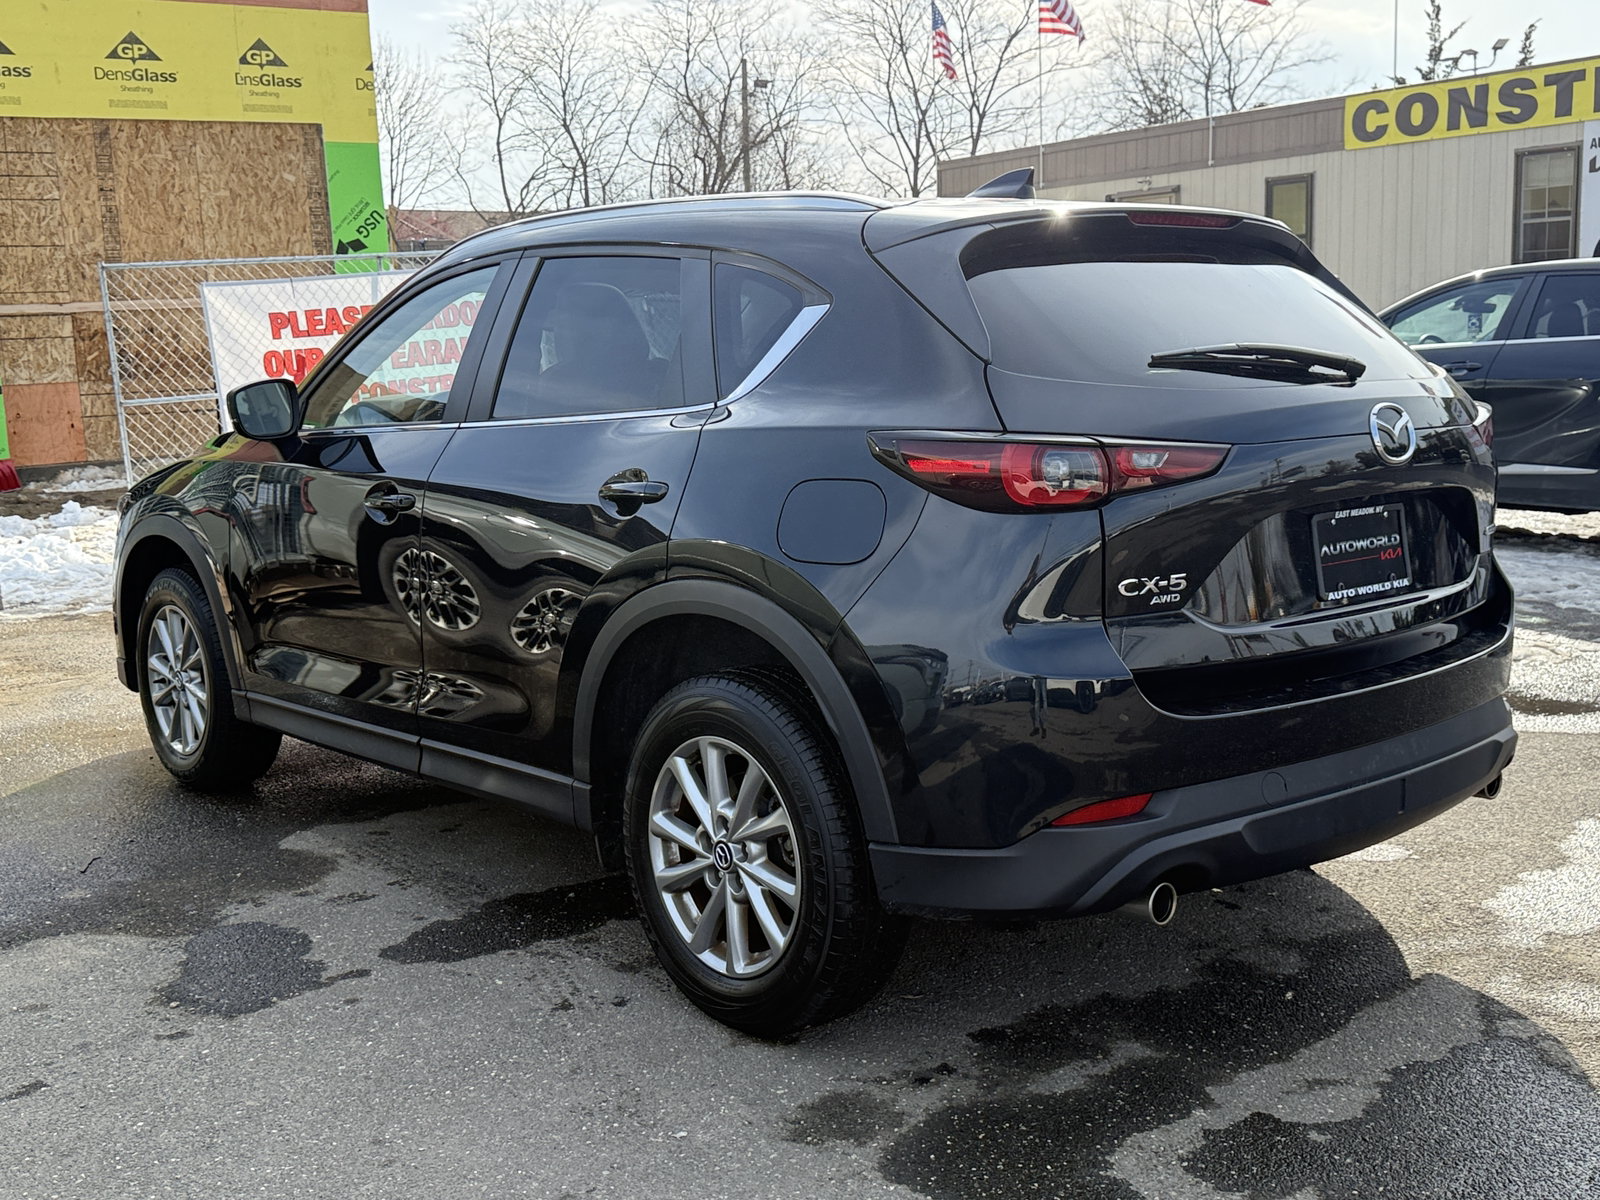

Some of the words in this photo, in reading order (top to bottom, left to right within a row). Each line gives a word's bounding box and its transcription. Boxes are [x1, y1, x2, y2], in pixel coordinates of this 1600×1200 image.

[116, 43, 148, 59] GP
[245, 50, 275, 65] GP
[0, 65, 32, 78] ass
[94, 66, 178, 83] DensGlass
[120, 85, 153, 94] Sheathing
[356, 77, 375, 91] De
[249, 89, 280, 99] Sheathing
[355, 209, 385, 239] USG
[351, 373, 455, 404] CONSTR
[1335, 509, 1350, 519] EAST
[1375, 505, 1384, 514] NY
[1320, 533, 1401, 557] AUTOWORLD
[1117, 573, 1187, 597] CX-5
[1328, 588, 1356, 601] AUTO
[1357, 583, 1392, 596] WORLD
[1392, 577, 1410, 589] KIA
[1149, 593, 1181, 606] AWD
